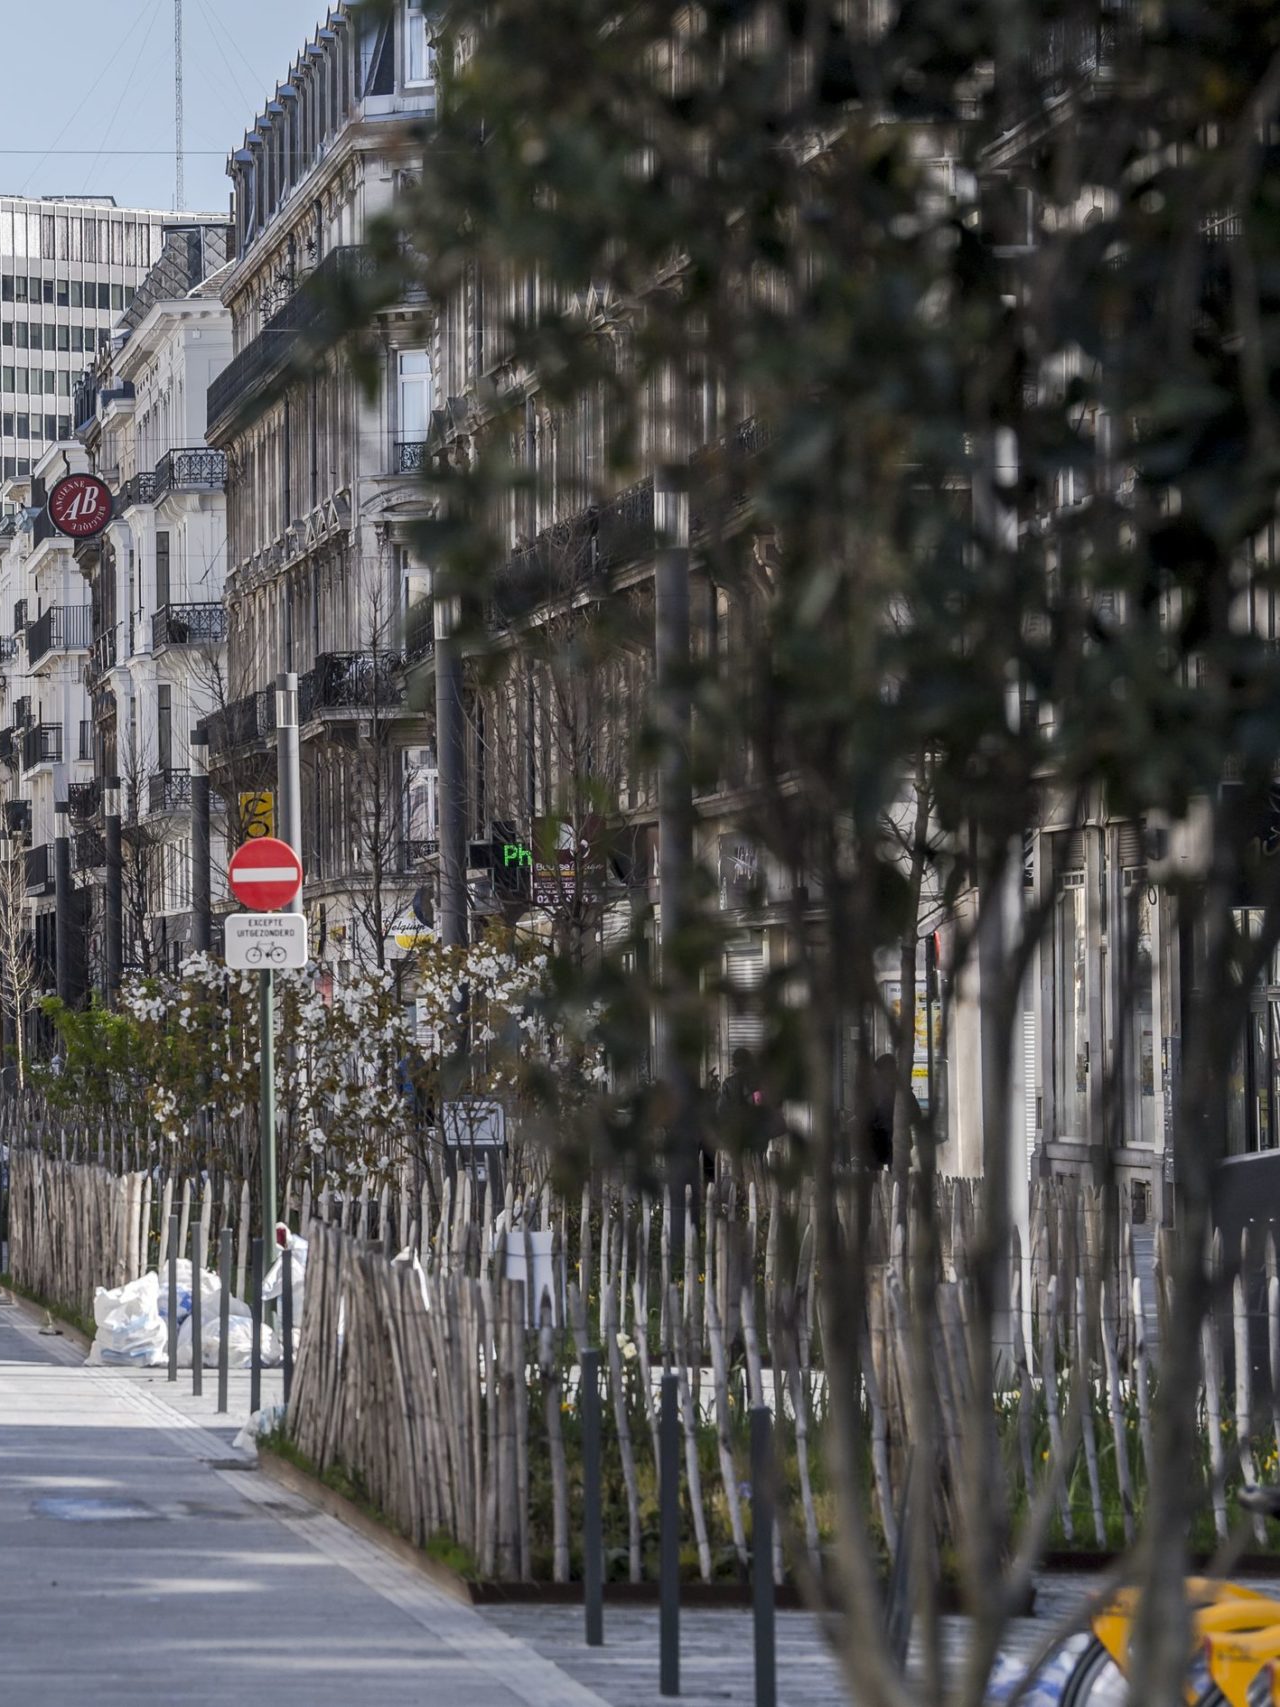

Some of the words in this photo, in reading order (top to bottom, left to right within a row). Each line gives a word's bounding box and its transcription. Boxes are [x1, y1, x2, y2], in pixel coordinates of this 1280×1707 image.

[55, 480, 85, 511] ANCIENNE
[59, 485, 100, 521] AB
[71, 505, 107, 532] BELGIQUE
[236, 928, 296, 938] UITGEZONDERD
